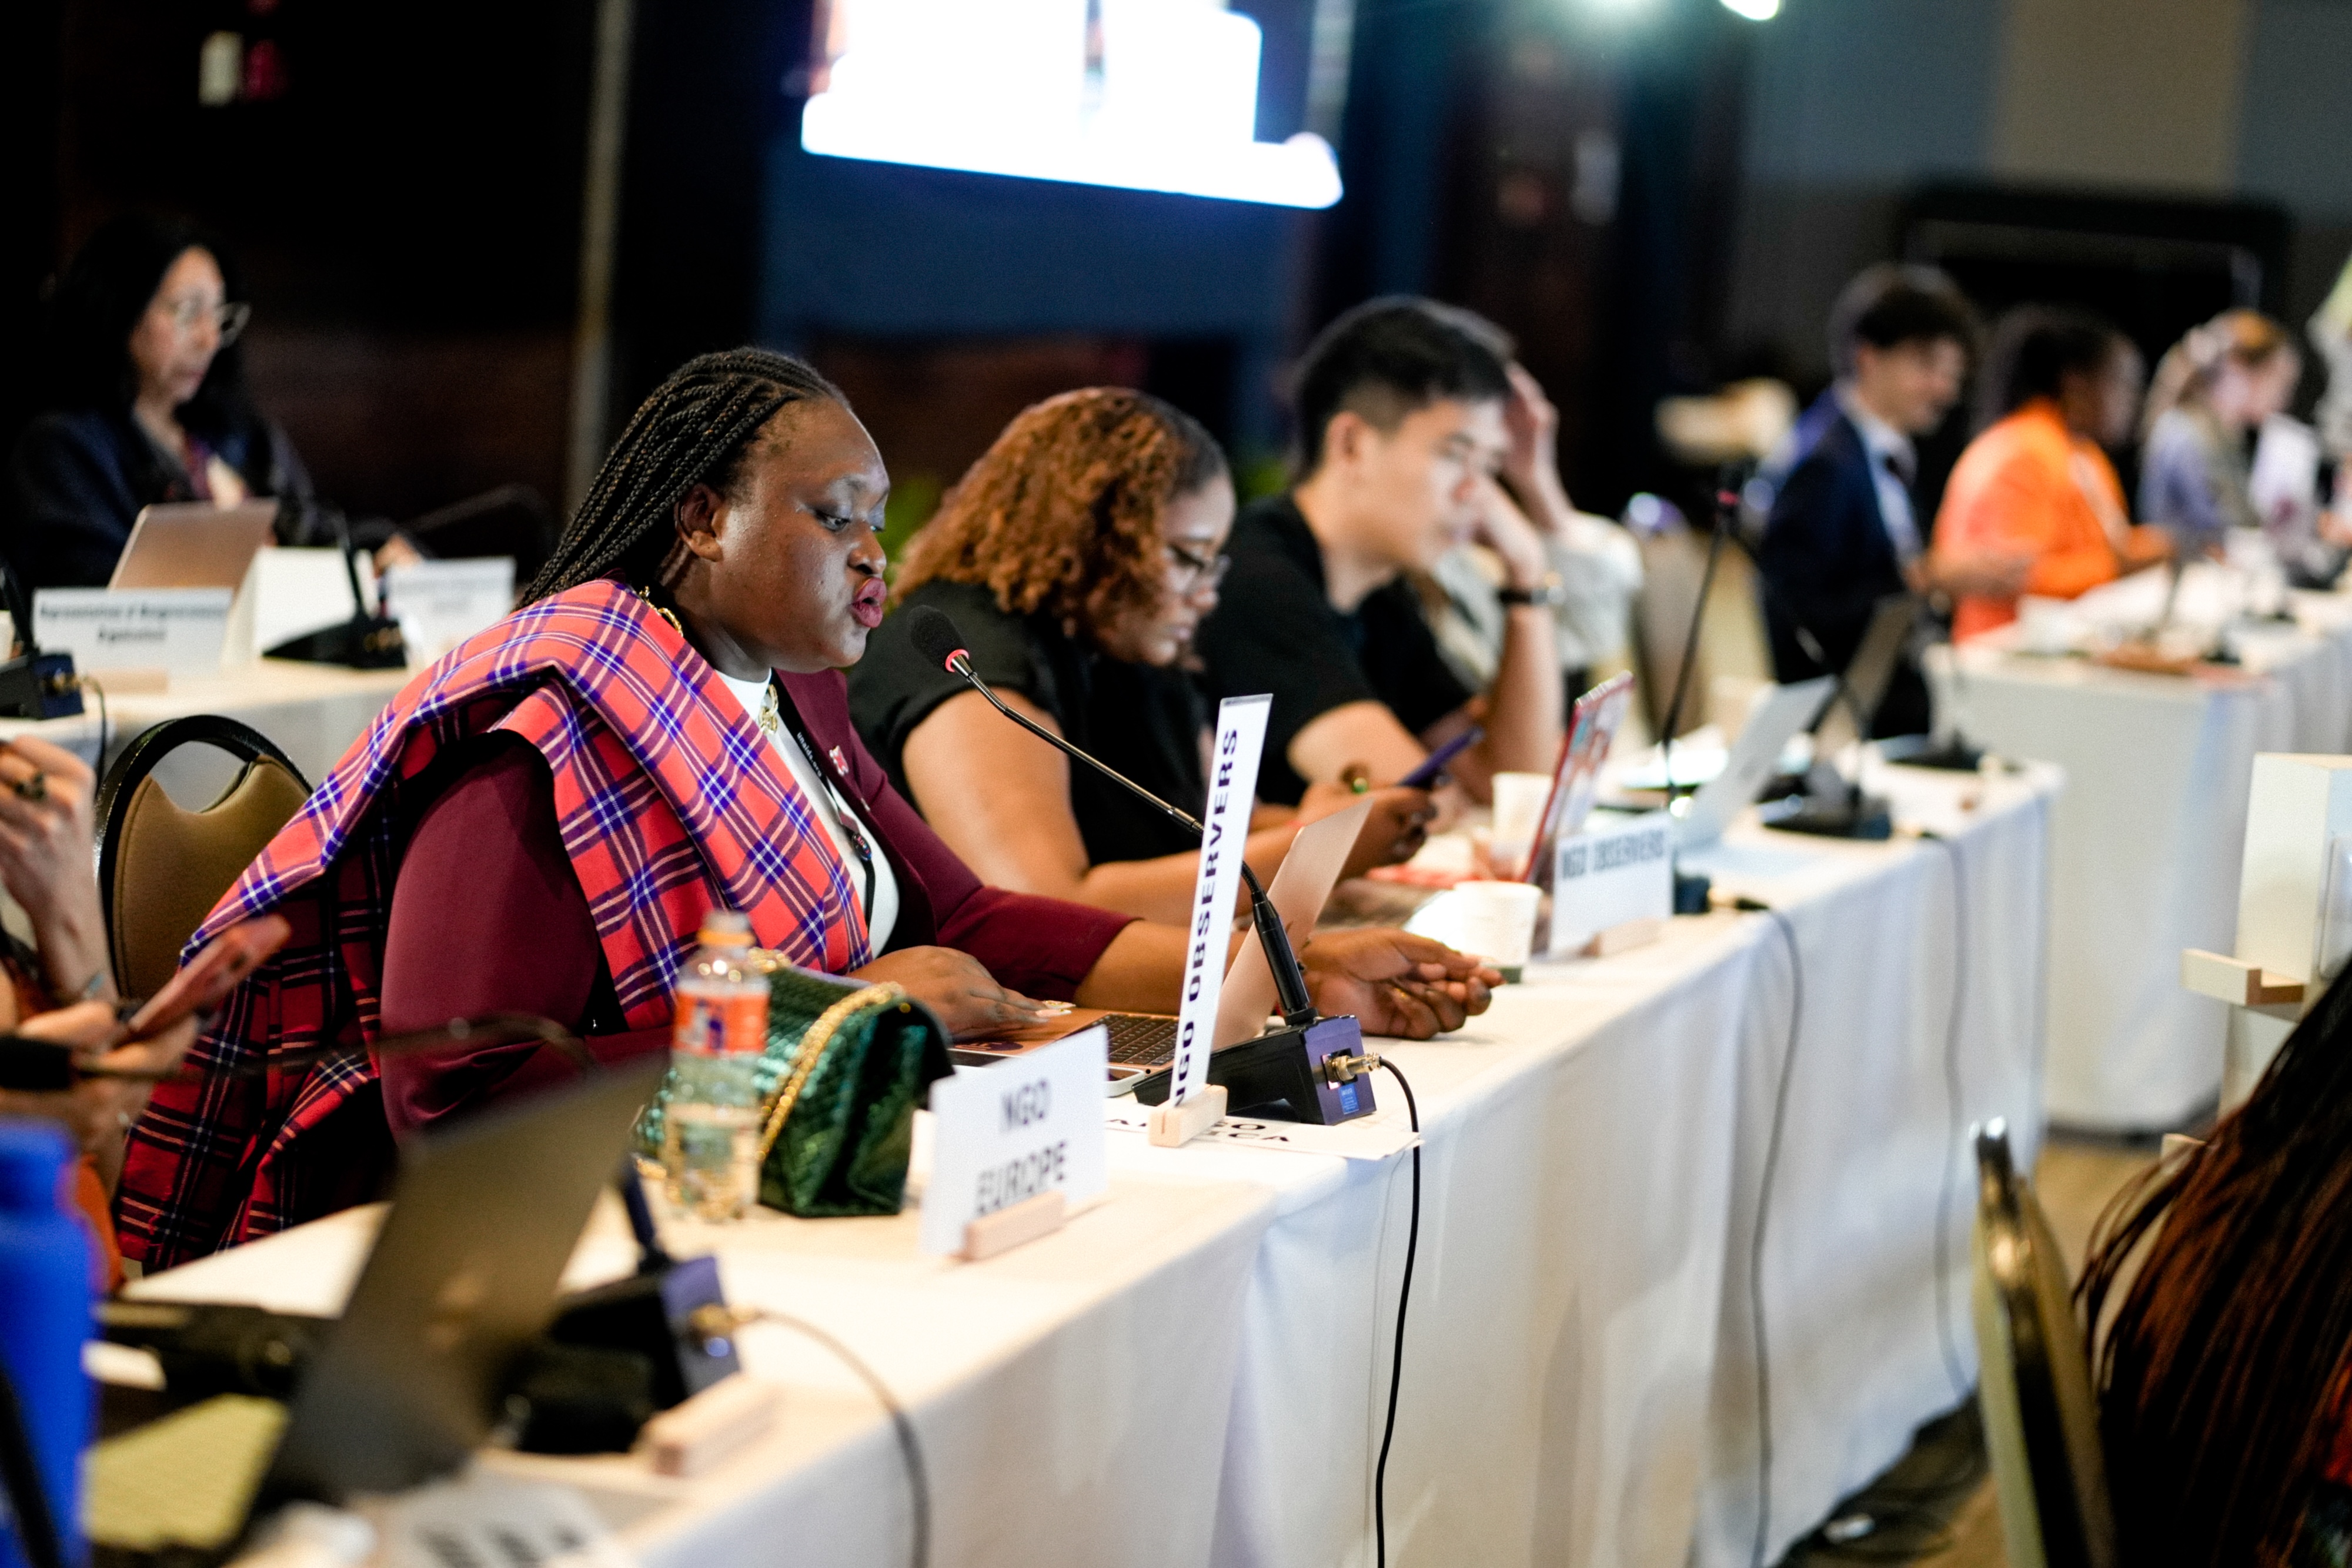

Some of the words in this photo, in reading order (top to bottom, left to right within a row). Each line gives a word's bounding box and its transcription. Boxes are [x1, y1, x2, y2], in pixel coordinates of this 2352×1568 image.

[797, 732, 821, 777] unaids.org
[1188, 730, 1237, 1001] OBSERVERS
[1002, 1079, 1052, 1131] NGO
[974, 1141, 1067, 1218] EUROPE
